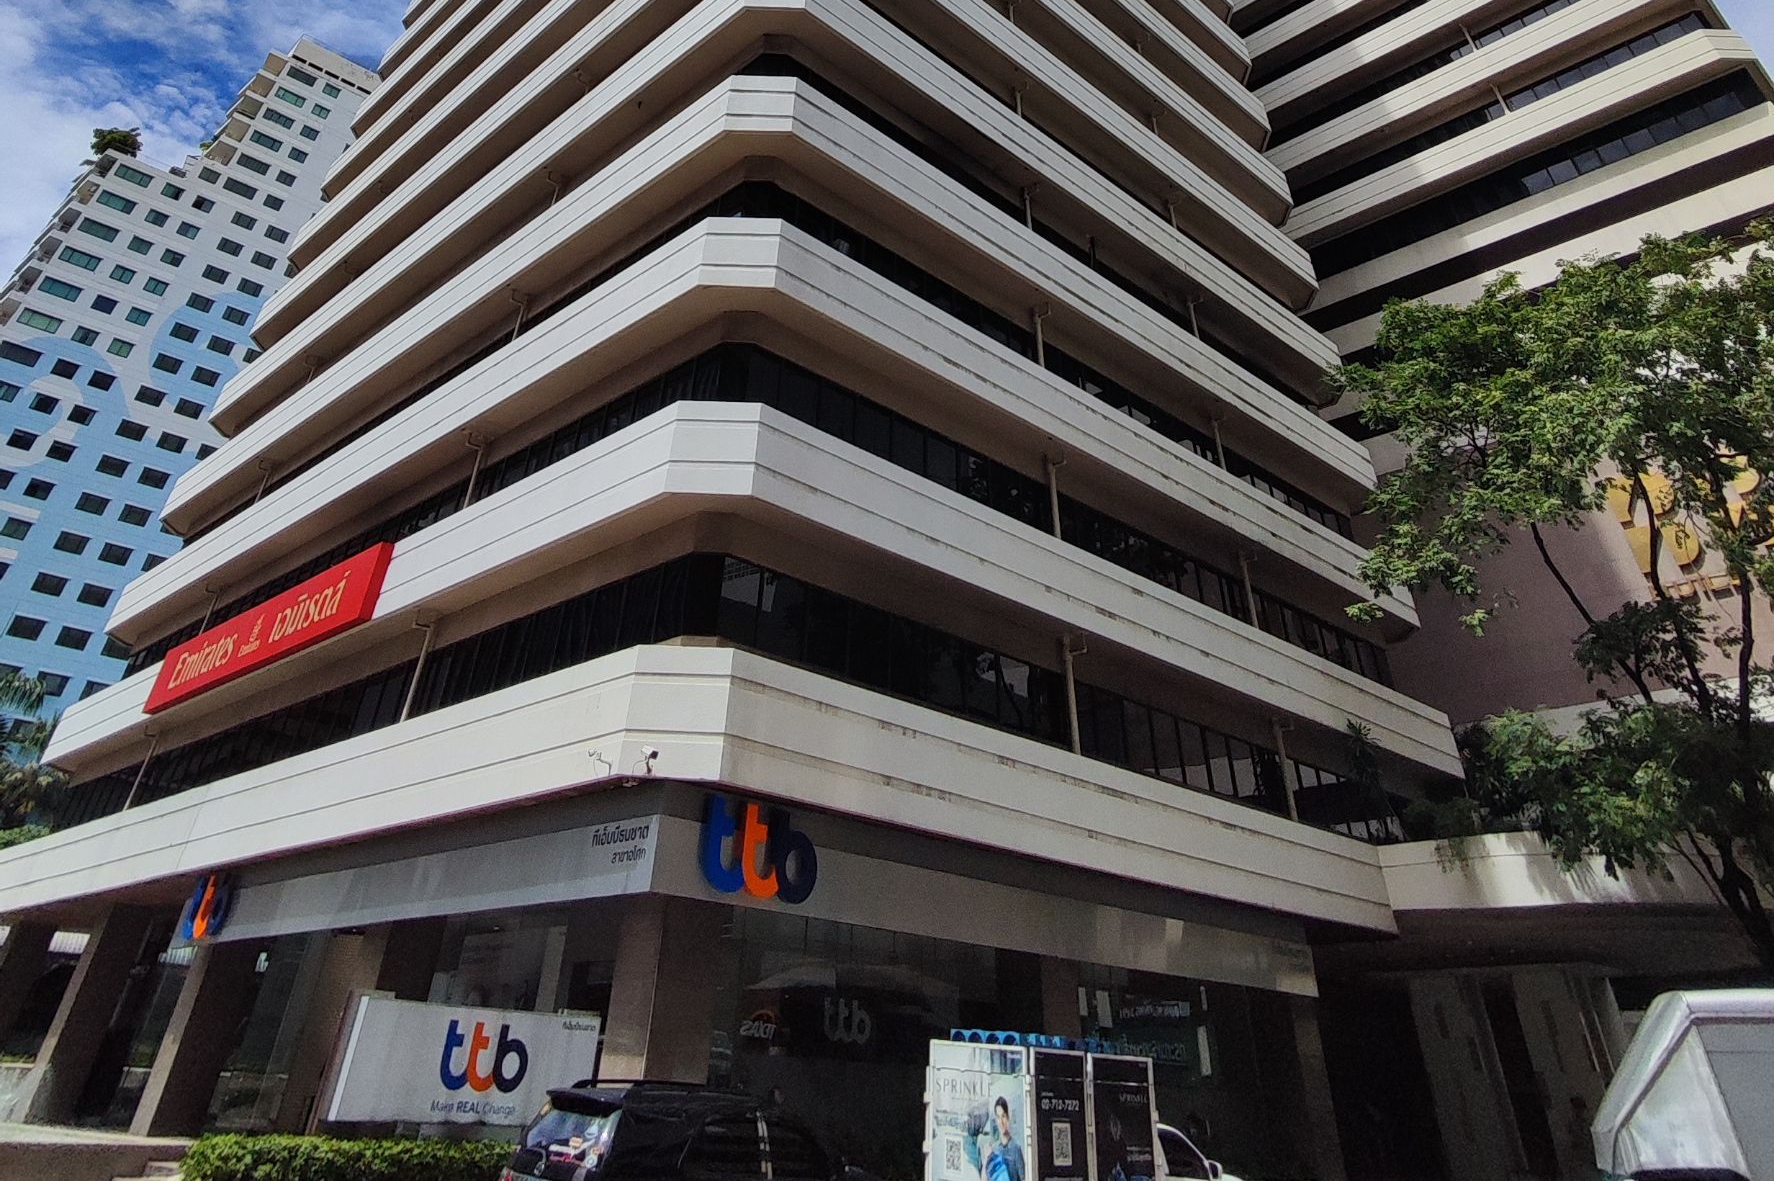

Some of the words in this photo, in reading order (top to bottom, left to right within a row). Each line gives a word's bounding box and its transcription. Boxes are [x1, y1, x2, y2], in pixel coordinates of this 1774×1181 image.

[268, 570, 352, 643] เอมิเรตส์
[167, 633, 239, 690] Emirates
[698, 793, 818, 905] ttb
[824, 996, 872, 1044] ttb
[440, 1019, 529, 1094] ttb
[430, 1099, 454, 1114] Make
[456, 1100, 480, 1114] REAL
